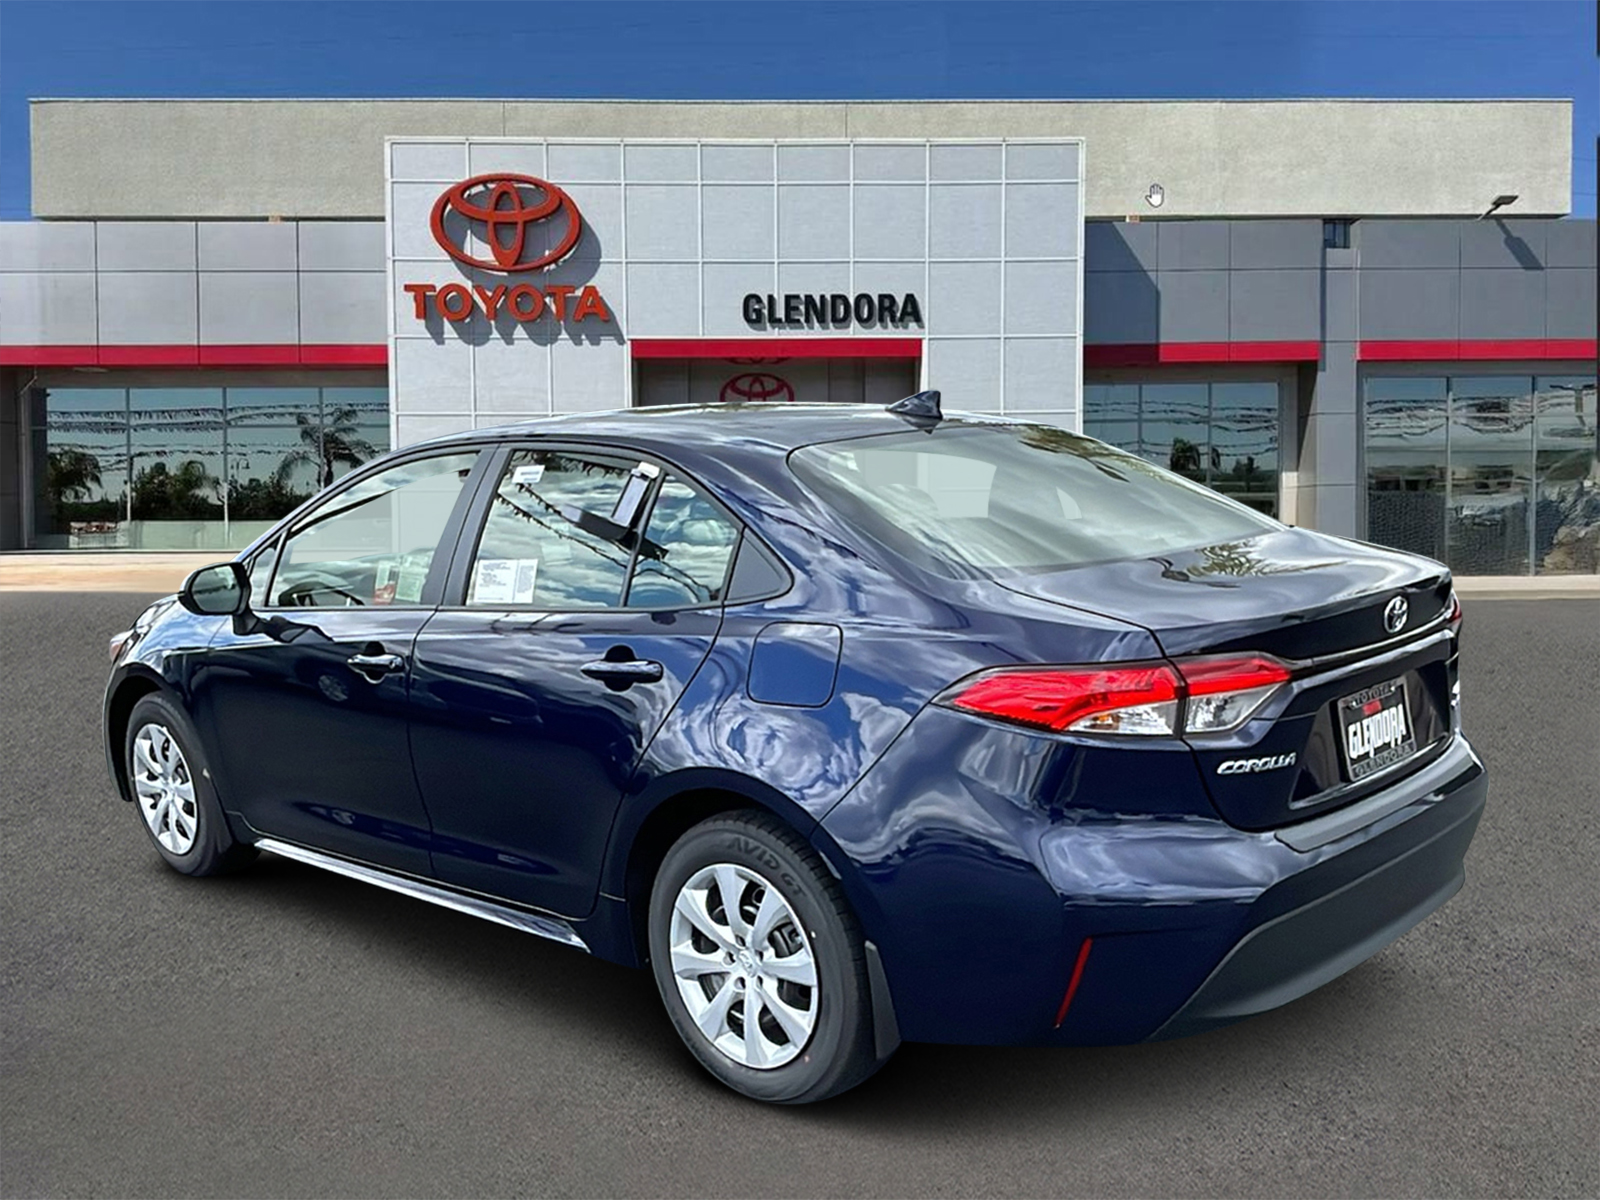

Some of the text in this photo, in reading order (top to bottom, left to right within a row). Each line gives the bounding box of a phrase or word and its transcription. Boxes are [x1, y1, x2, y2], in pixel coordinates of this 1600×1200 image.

[404, 283, 610, 322] TOYOTA
[742, 293, 923, 325] GLENDORA
[1348, 703, 1407, 759] GLENDORA
[1217, 752, 1296, 774] COROLLA
